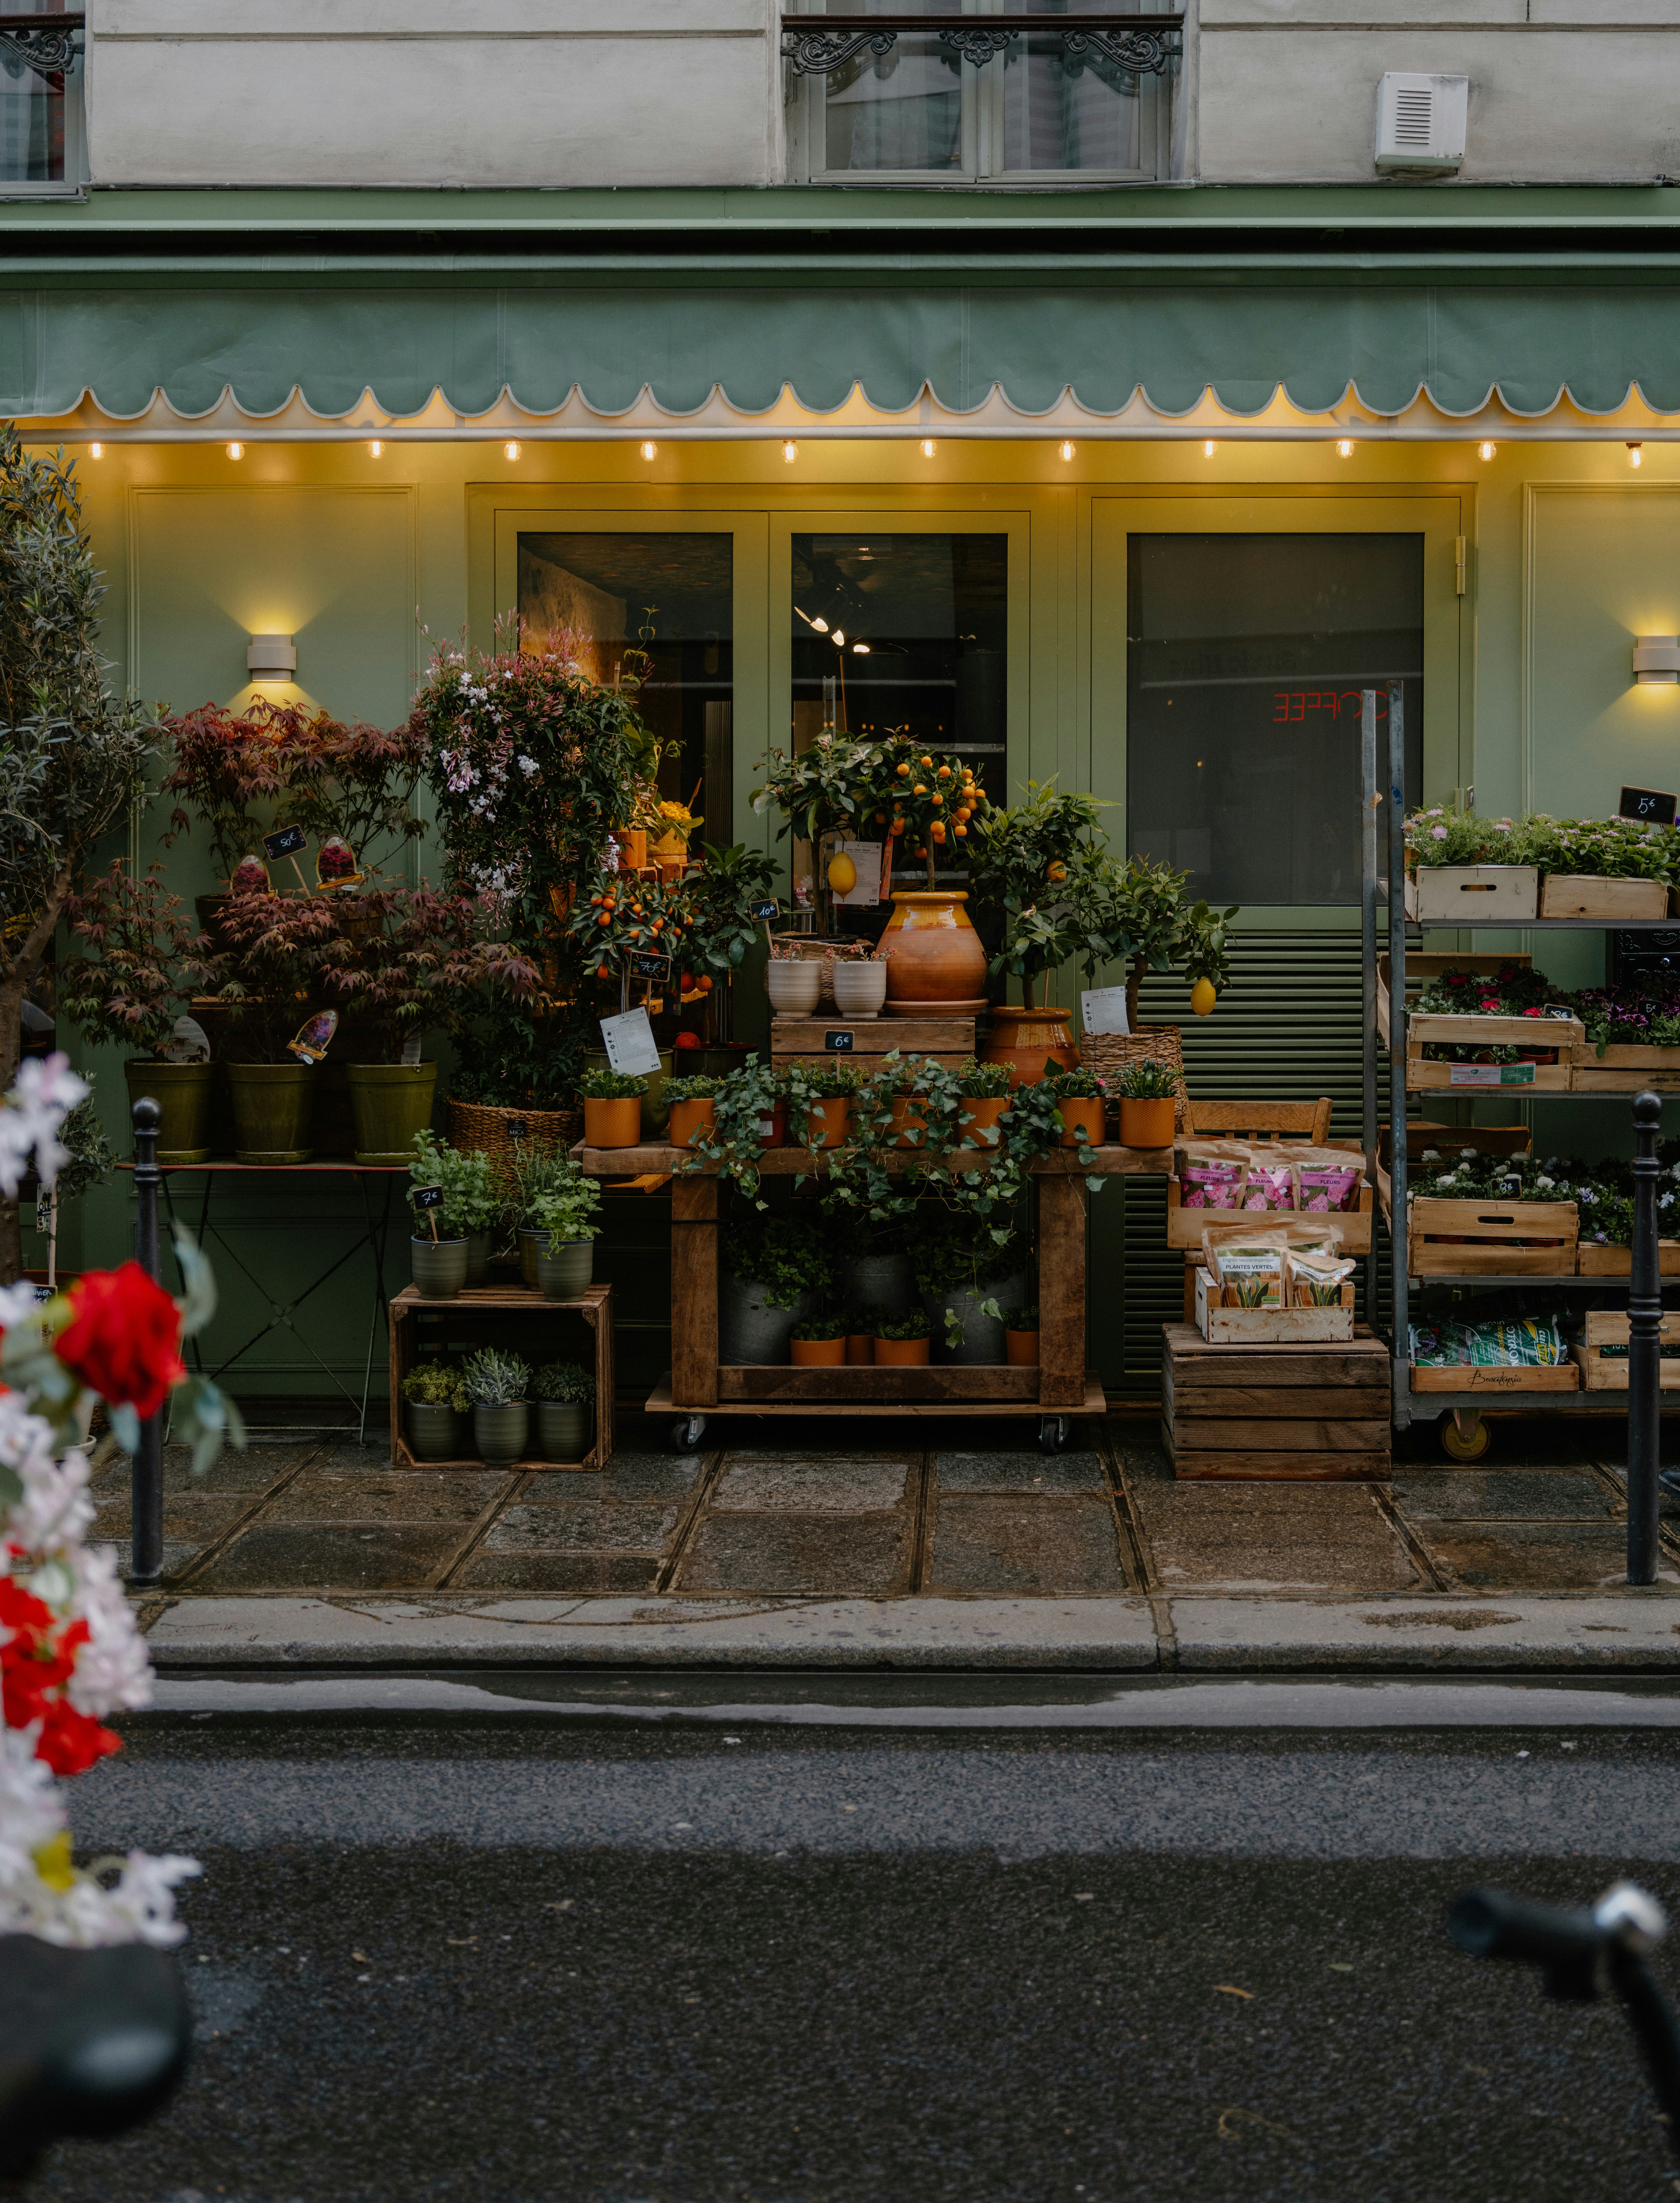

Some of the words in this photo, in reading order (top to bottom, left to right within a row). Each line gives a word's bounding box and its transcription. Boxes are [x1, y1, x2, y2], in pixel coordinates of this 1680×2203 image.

[1638, 798, 1655, 814] 5€
[280, 833, 297, 847] 50€
[759, 905, 775, 916] 10€
[639, 962, 661, 972] 70€
[1646, 1003, 1657, 1013] 5€
[835, 1036, 849, 1047] 6€
[422, 1192, 438, 1205] 7€
[1467, 1370, 1522, 1388] Beautensia
